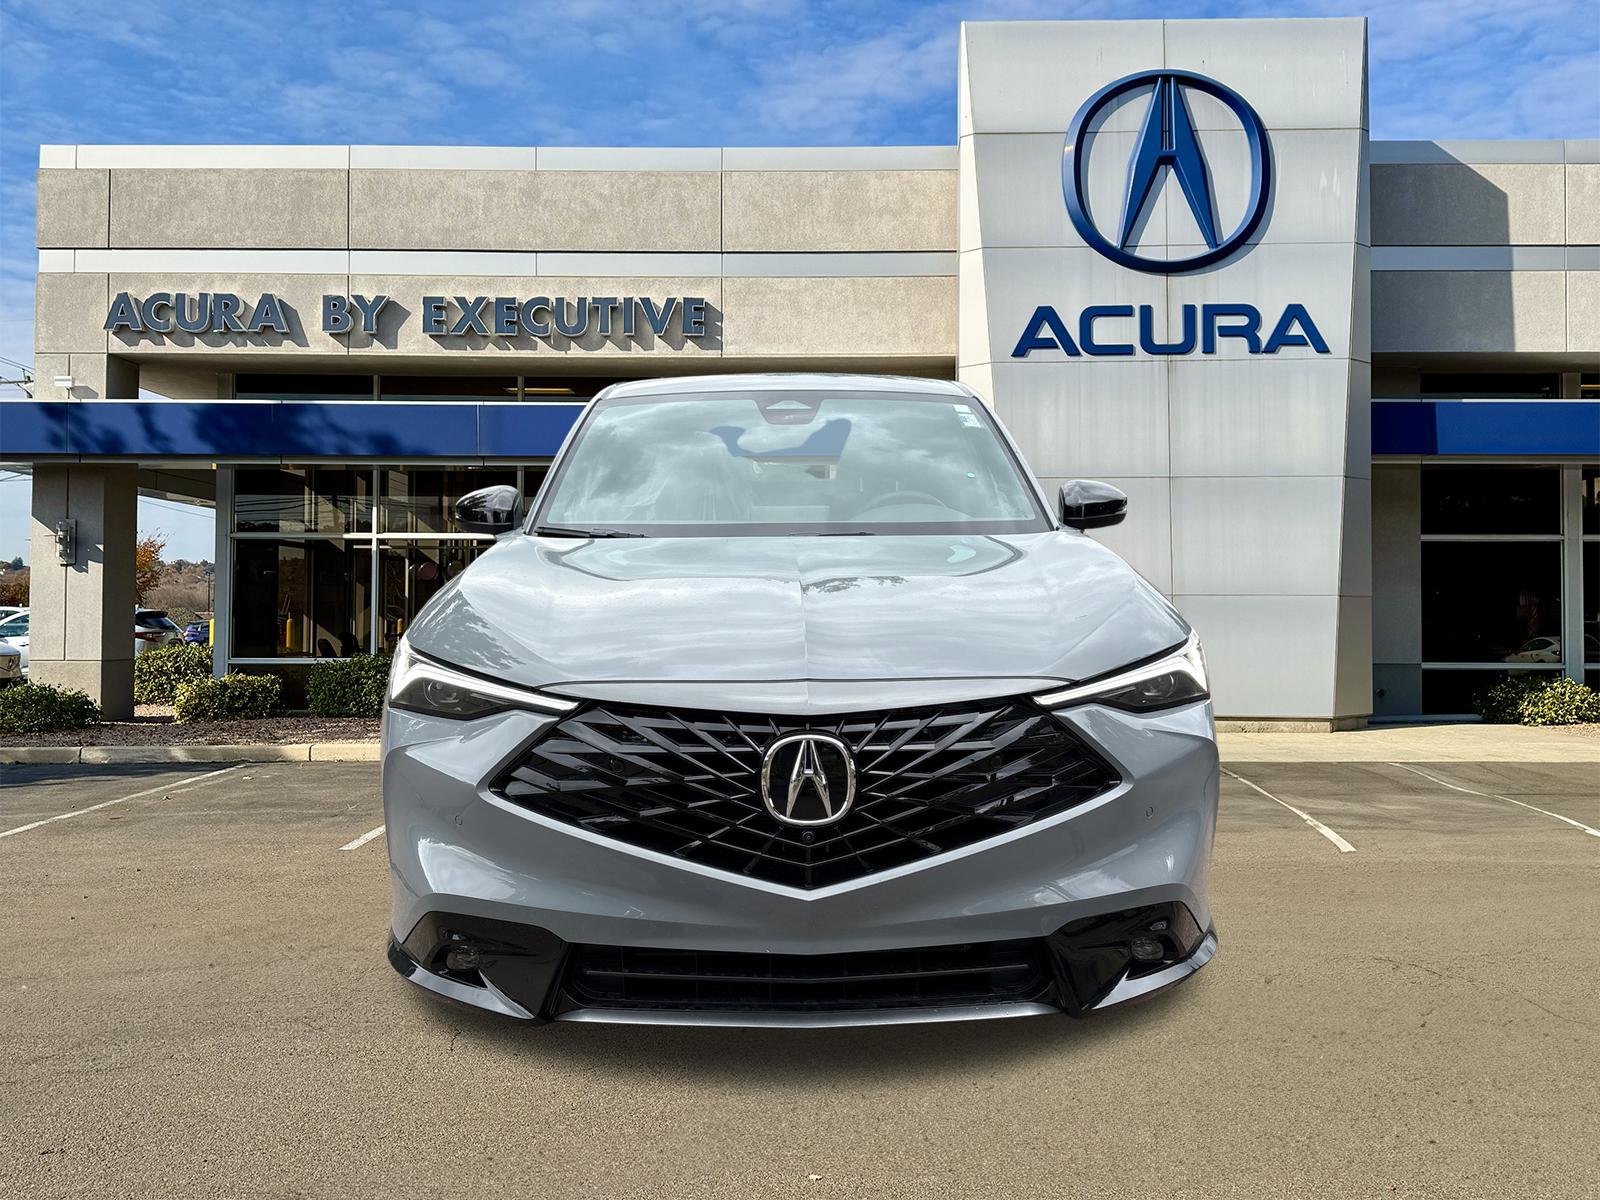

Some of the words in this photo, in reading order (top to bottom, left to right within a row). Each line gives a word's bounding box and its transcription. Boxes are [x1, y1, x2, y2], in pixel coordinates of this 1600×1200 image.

[104, 292, 290, 333] ACURA
[322, 294, 390, 334] BY
[422, 296, 706, 337] EXECUTIVE
[1010, 303, 1332, 357] ACURA
